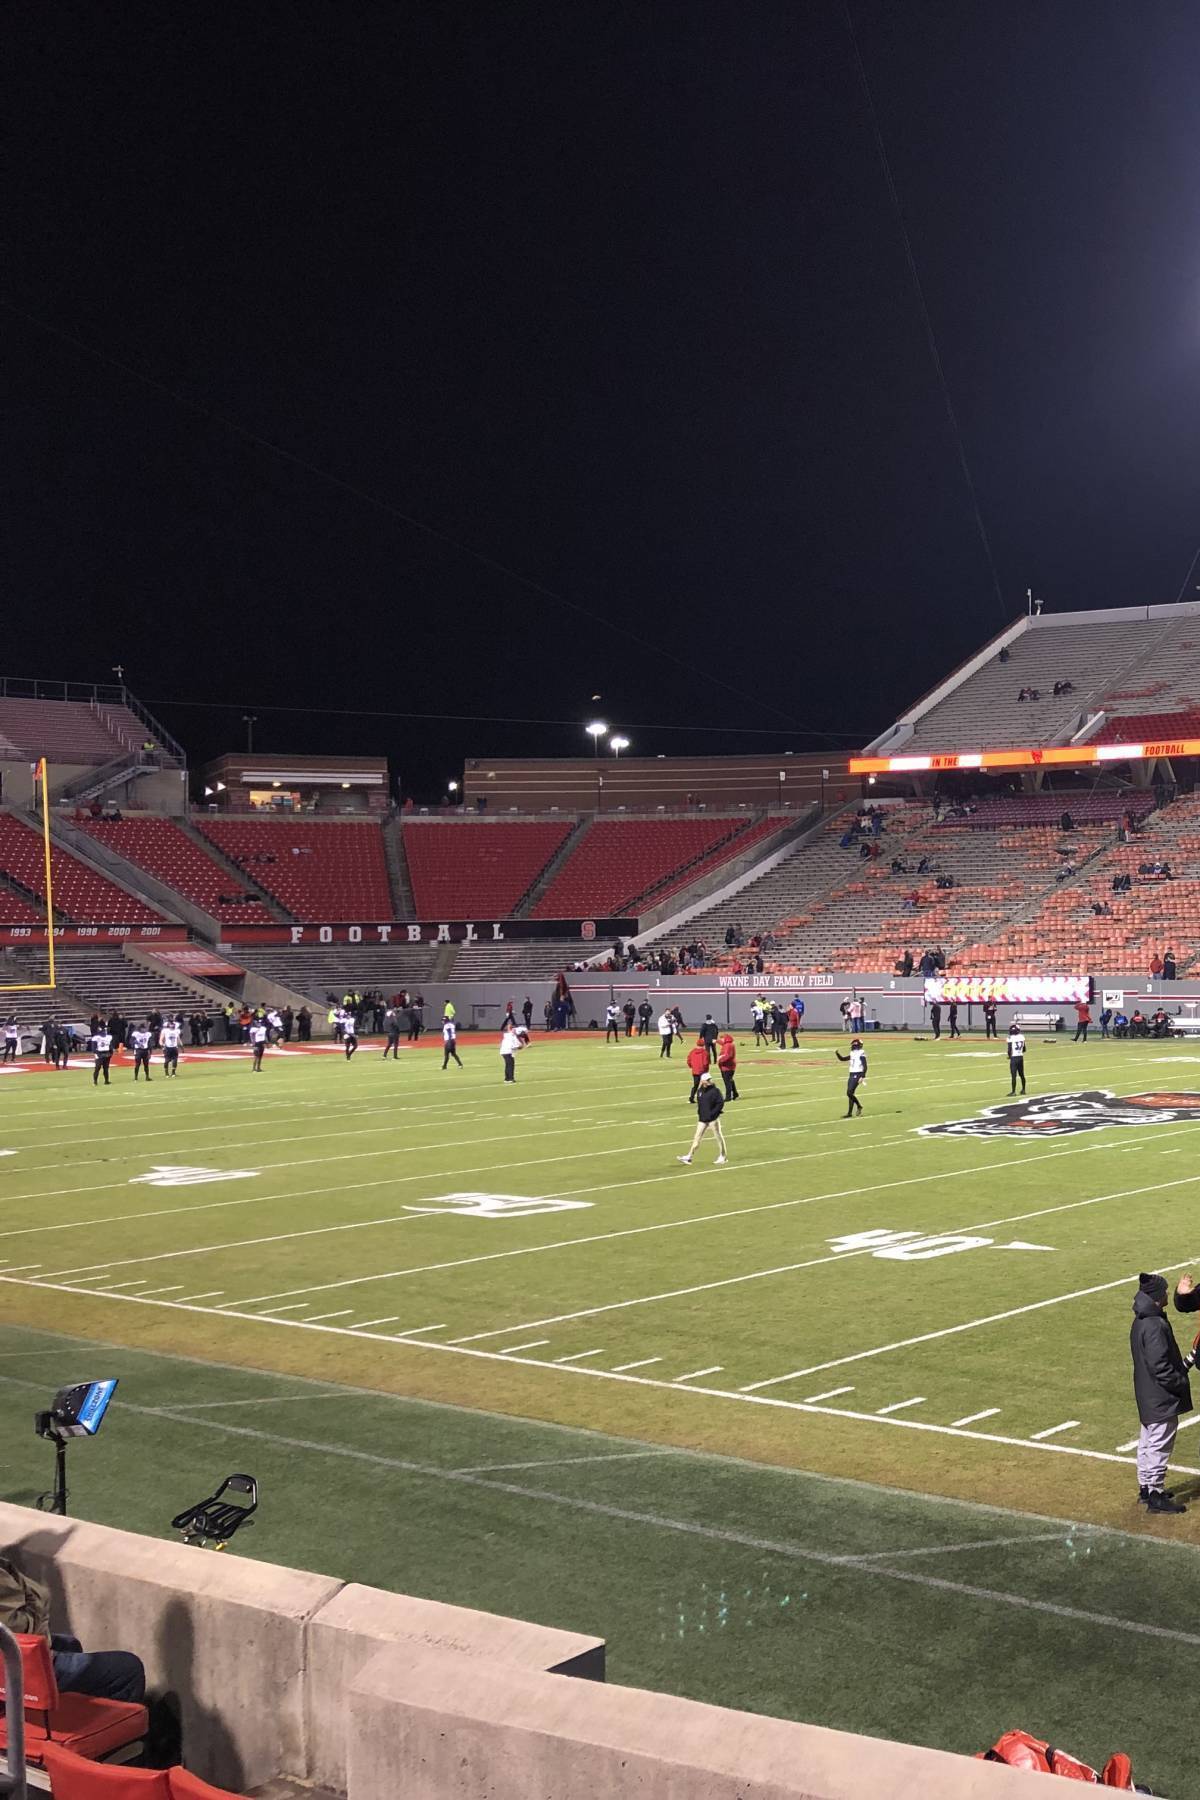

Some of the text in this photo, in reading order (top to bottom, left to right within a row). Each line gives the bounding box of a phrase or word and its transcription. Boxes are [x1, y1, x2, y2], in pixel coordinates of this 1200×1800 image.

[1144, 744, 1186, 756] FOOTBALL
[932, 756, 958, 767] IN THE
[10, 928, 31, 937] 1993
[108, 927, 131, 936] 2000
[141, 927, 161, 936] 2001
[291, 924, 504, 943] FOOTBALL
[719, 975, 834, 987] WAYNE DAY FAMILY FIELD
